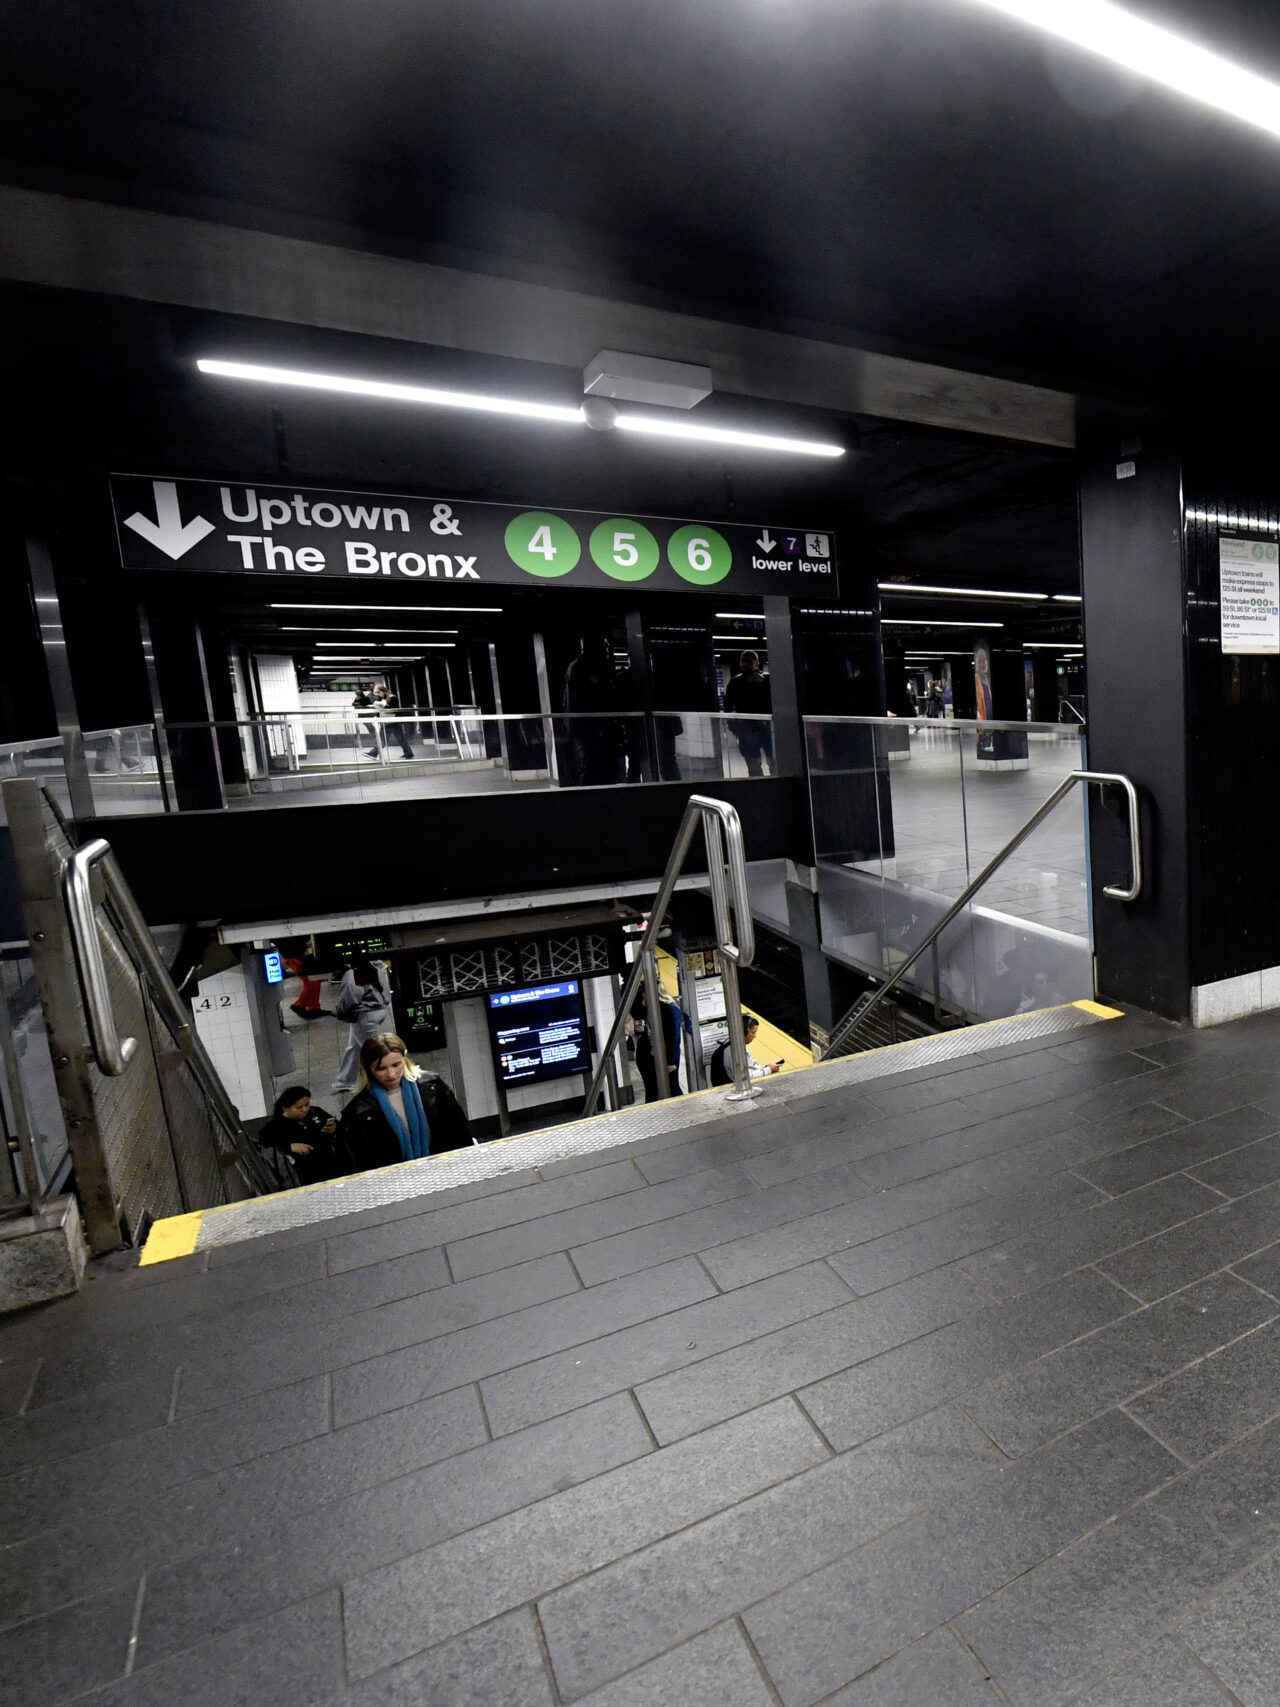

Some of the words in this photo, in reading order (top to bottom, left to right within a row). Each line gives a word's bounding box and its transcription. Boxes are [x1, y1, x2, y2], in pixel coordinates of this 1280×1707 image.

[220, 487, 411, 533] Uptown
[430, 503, 463, 536] &
[527, 525, 558, 562] 4
[612, 532, 639, 567] 5
[687, 538, 713, 573] 6
[786, 536, 797, 551] 7
[227, 535, 326, 573] The
[344, 541, 481, 580] Bronx
[751, 555, 793, 572] lower
[798, 558, 831, 574] level
[1222, 568, 1241, 577] Uptown
[1239, 597, 1250, 605] take
[1230, 613, 1256, 621] downtown
[200, 996, 231, 1009] 42
